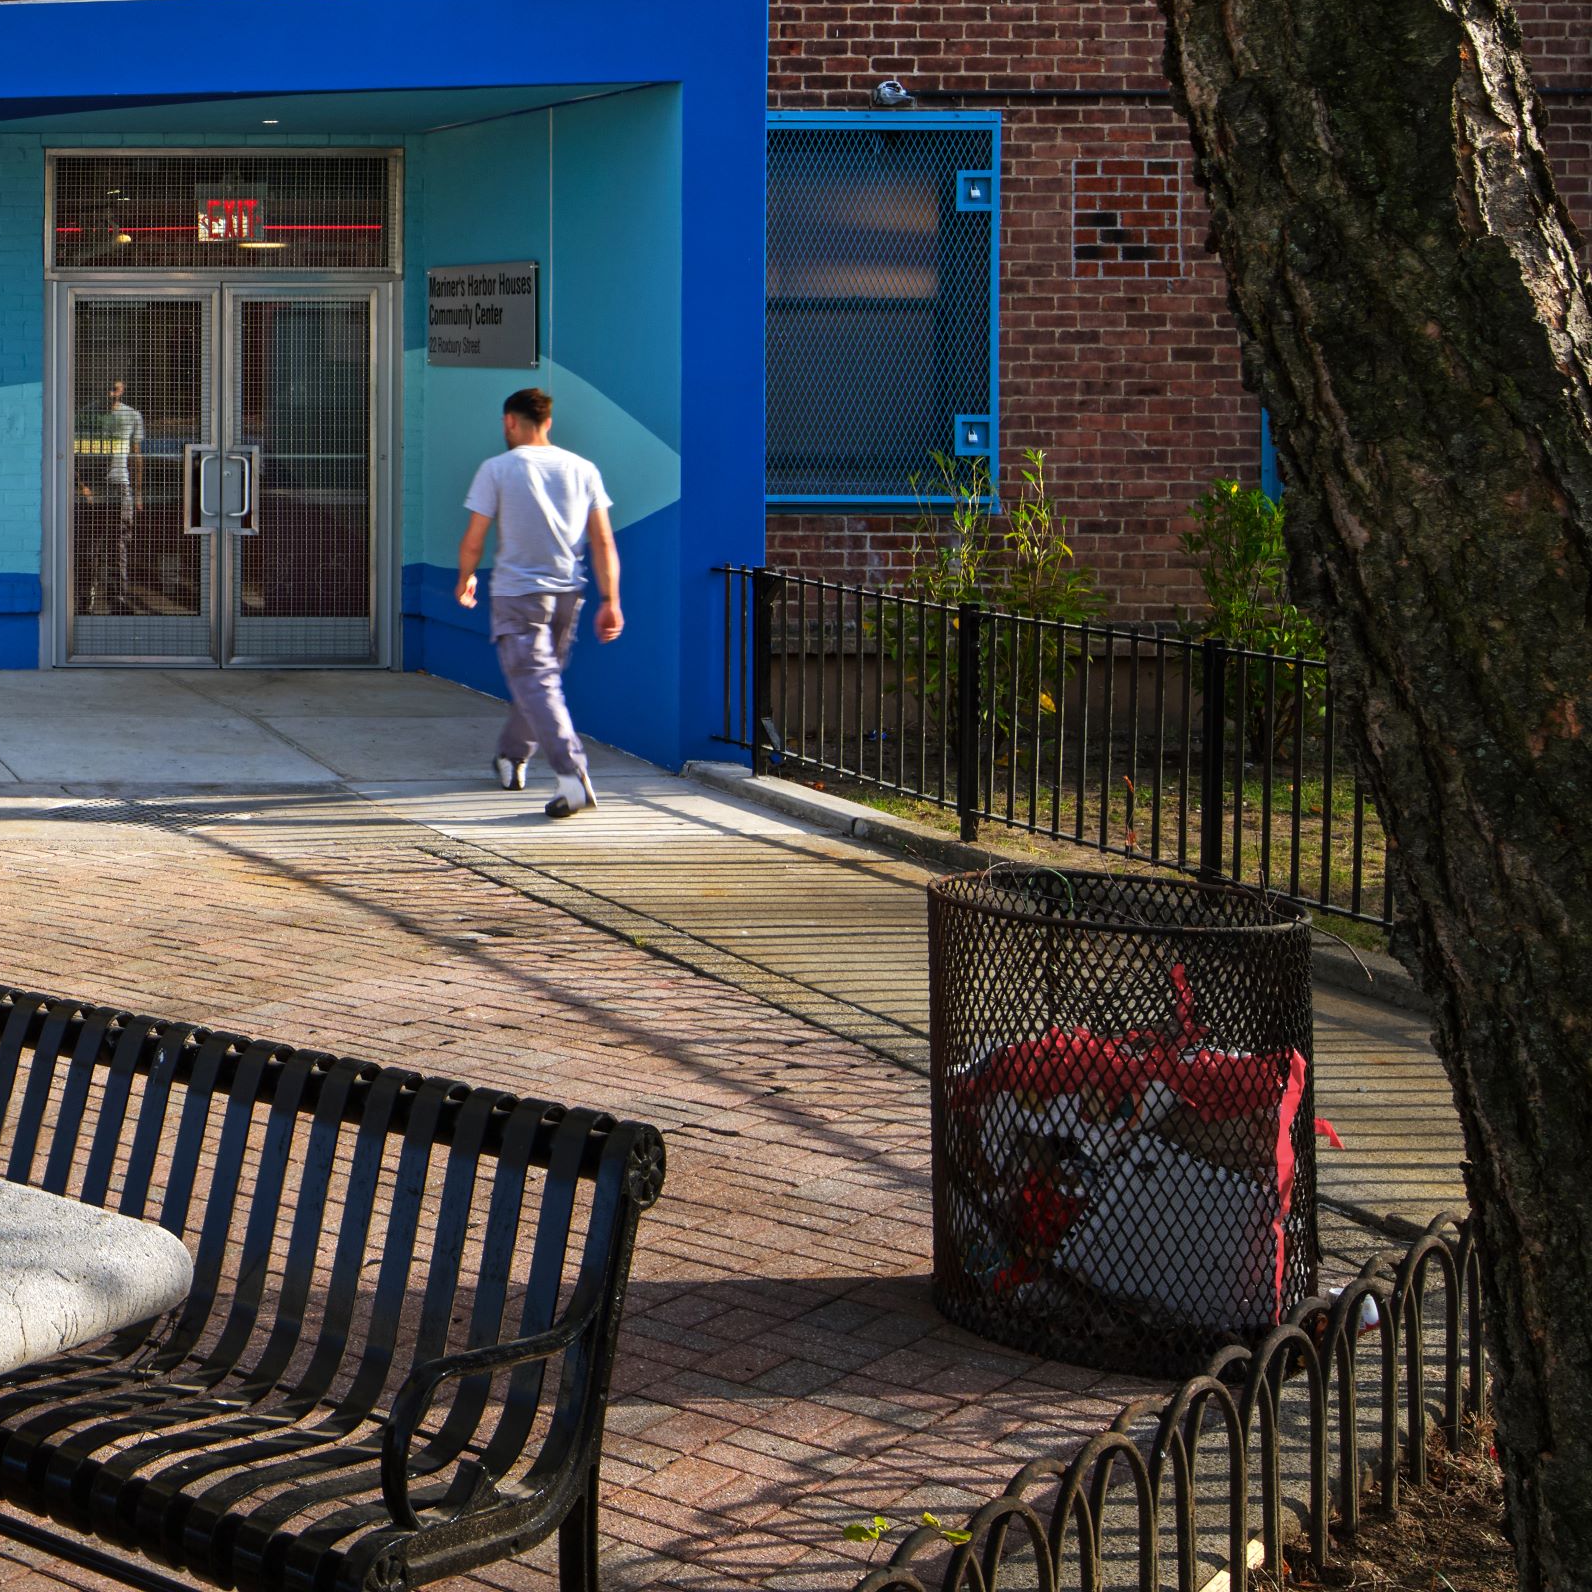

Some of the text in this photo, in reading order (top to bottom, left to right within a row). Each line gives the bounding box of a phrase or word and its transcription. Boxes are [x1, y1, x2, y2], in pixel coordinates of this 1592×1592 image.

[207, 199, 258, 238] EXIT
[429, 272, 532, 298] Mariner's Harbor Houses
[429, 303, 503, 330] Community Center
[429, 336, 437, 353] 22
[463, 336, 481, 354] Street
